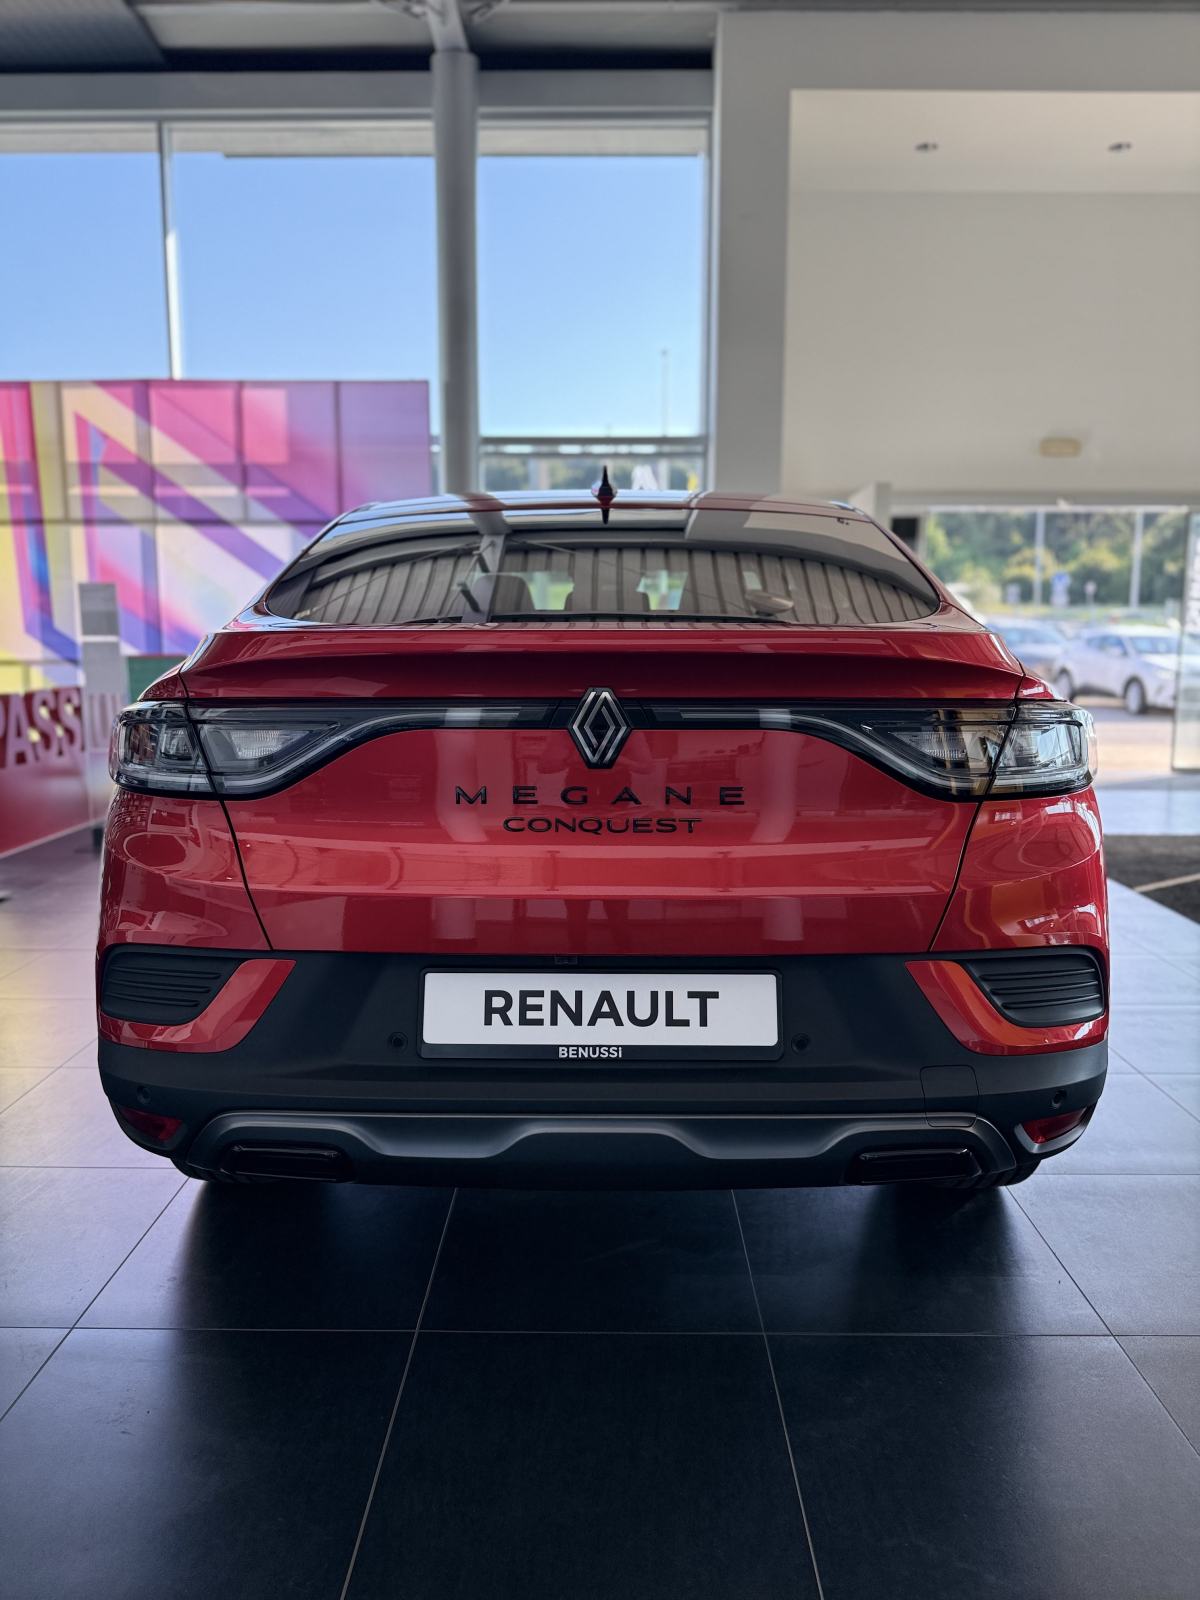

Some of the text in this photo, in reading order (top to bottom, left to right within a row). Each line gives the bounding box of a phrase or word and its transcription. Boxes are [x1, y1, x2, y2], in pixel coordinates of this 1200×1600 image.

[455, 786, 745, 806] MEGANE
[503, 817, 702, 835] CONQUEST
[483, 990, 719, 1027] RENAULT
[558, 1046, 623, 1059] BENUSSI
